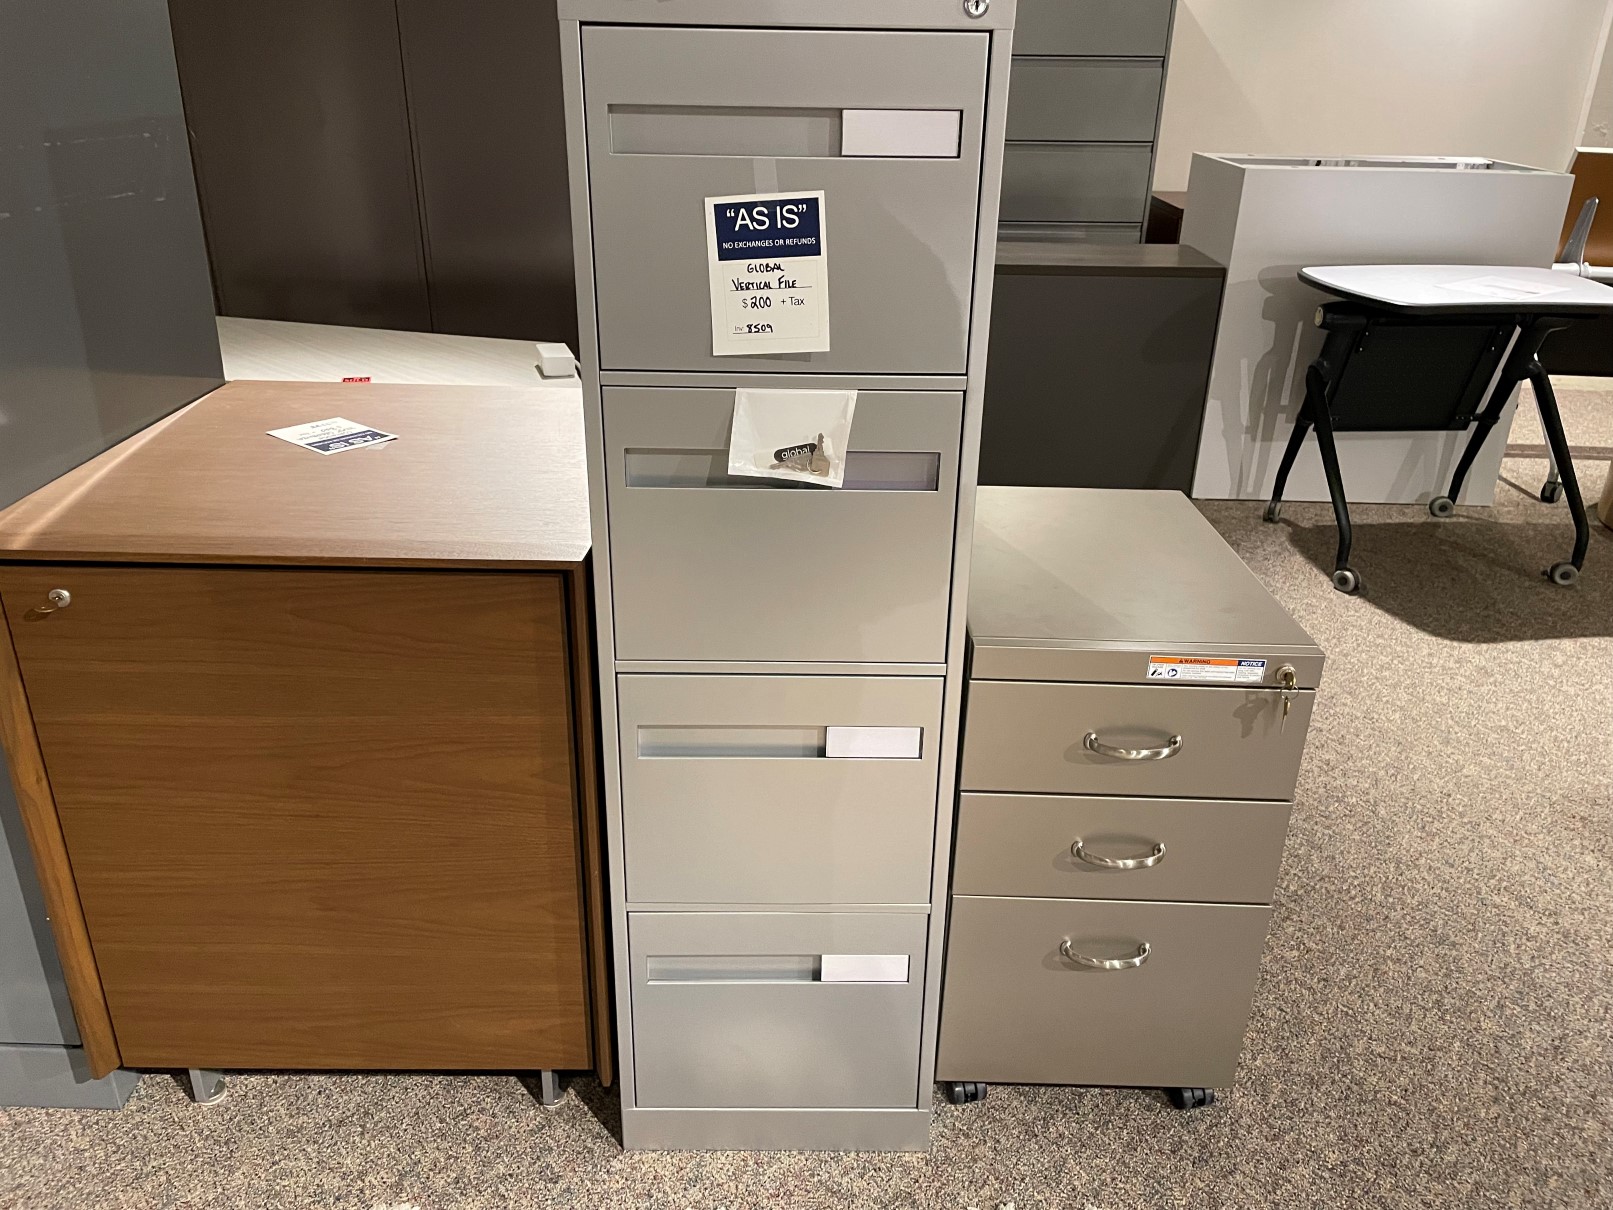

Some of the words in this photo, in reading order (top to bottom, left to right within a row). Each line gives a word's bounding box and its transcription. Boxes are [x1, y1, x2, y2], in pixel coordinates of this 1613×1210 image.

[734, 239, 774, 249] EXCHANGES
[774, 238, 784, 246] OR
[785, 237, 816, 245] REFUNDS
[747, 263, 785, 273] GLOBAL
[731, 278, 773, 291] VERTICAL
[777, 275, 797, 289] FILE
[789, 296, 805, 306] Tax
[746, 323, 774, 333] 8509
[781, 445, 810, 460] global
